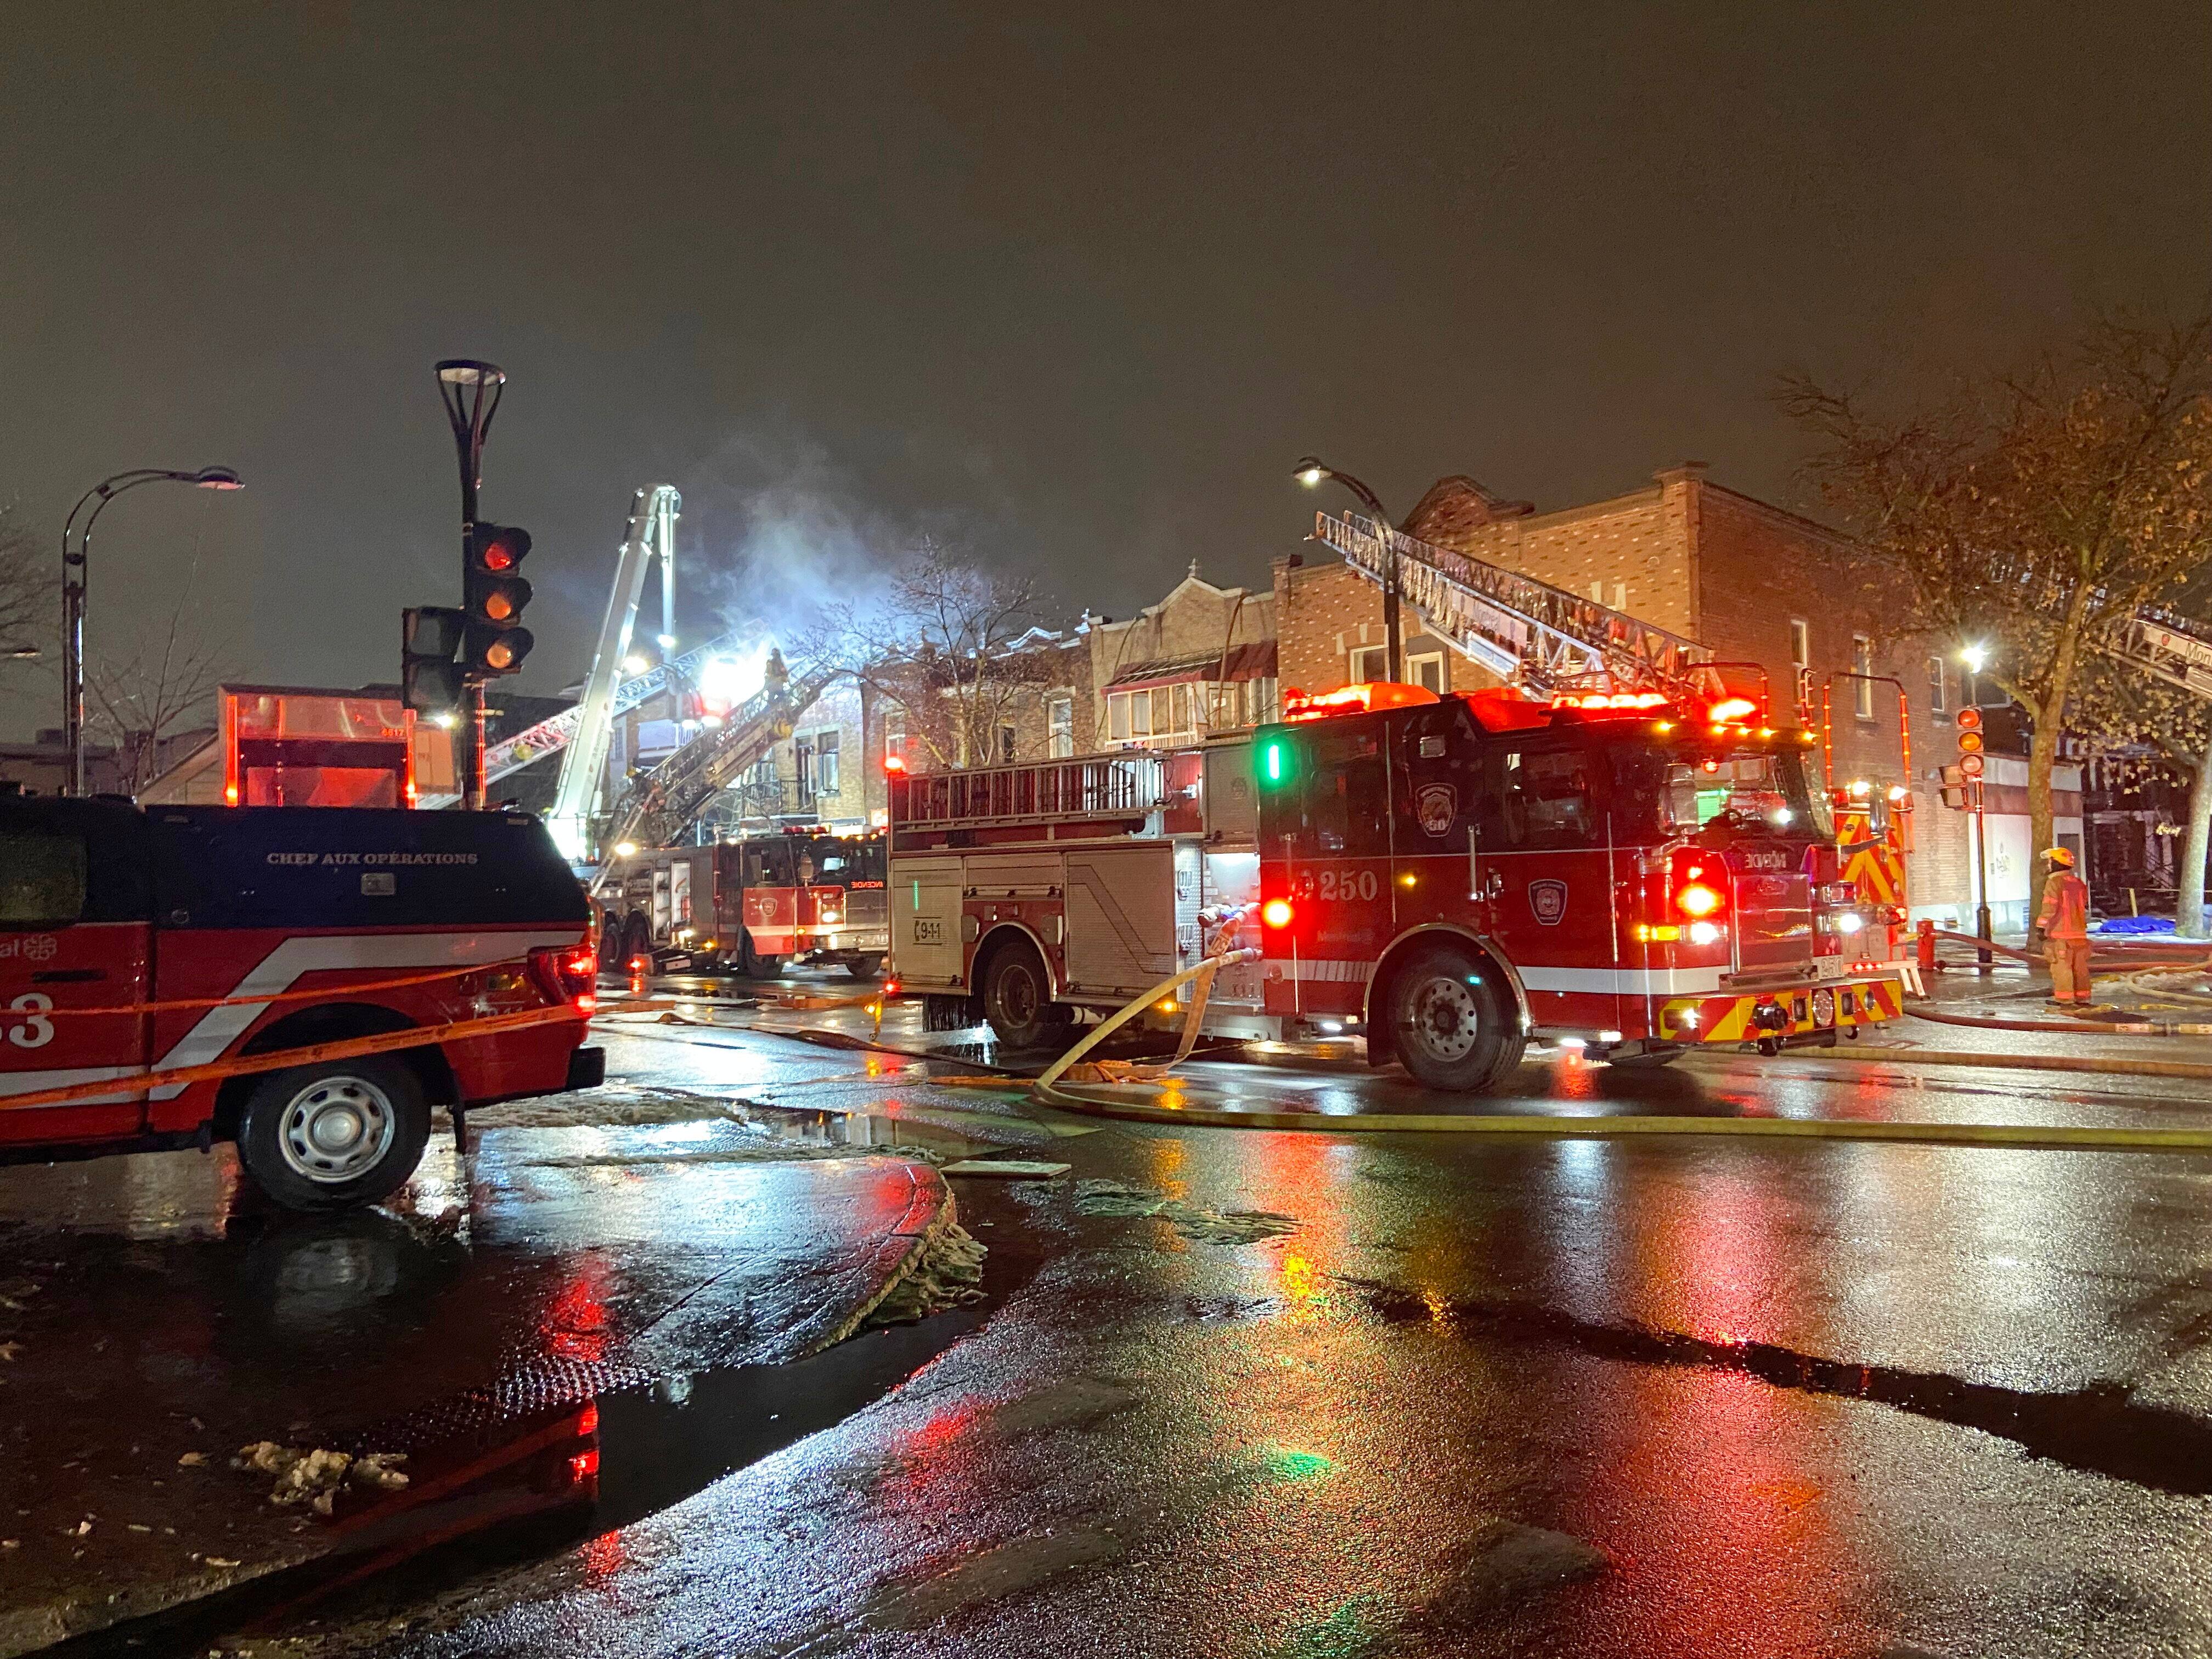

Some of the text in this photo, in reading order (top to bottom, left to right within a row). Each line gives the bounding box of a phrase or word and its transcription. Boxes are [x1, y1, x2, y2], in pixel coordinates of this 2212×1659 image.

[267, 851, 478, 864] CHEF AUX OPÉRATIONS
[1319, 870, 1378, 901] 250
[921, 922, 940, 939] 9-1-1
[1822, 957, 1843, 977] 250
[0, 992, 54, 1048] 3
